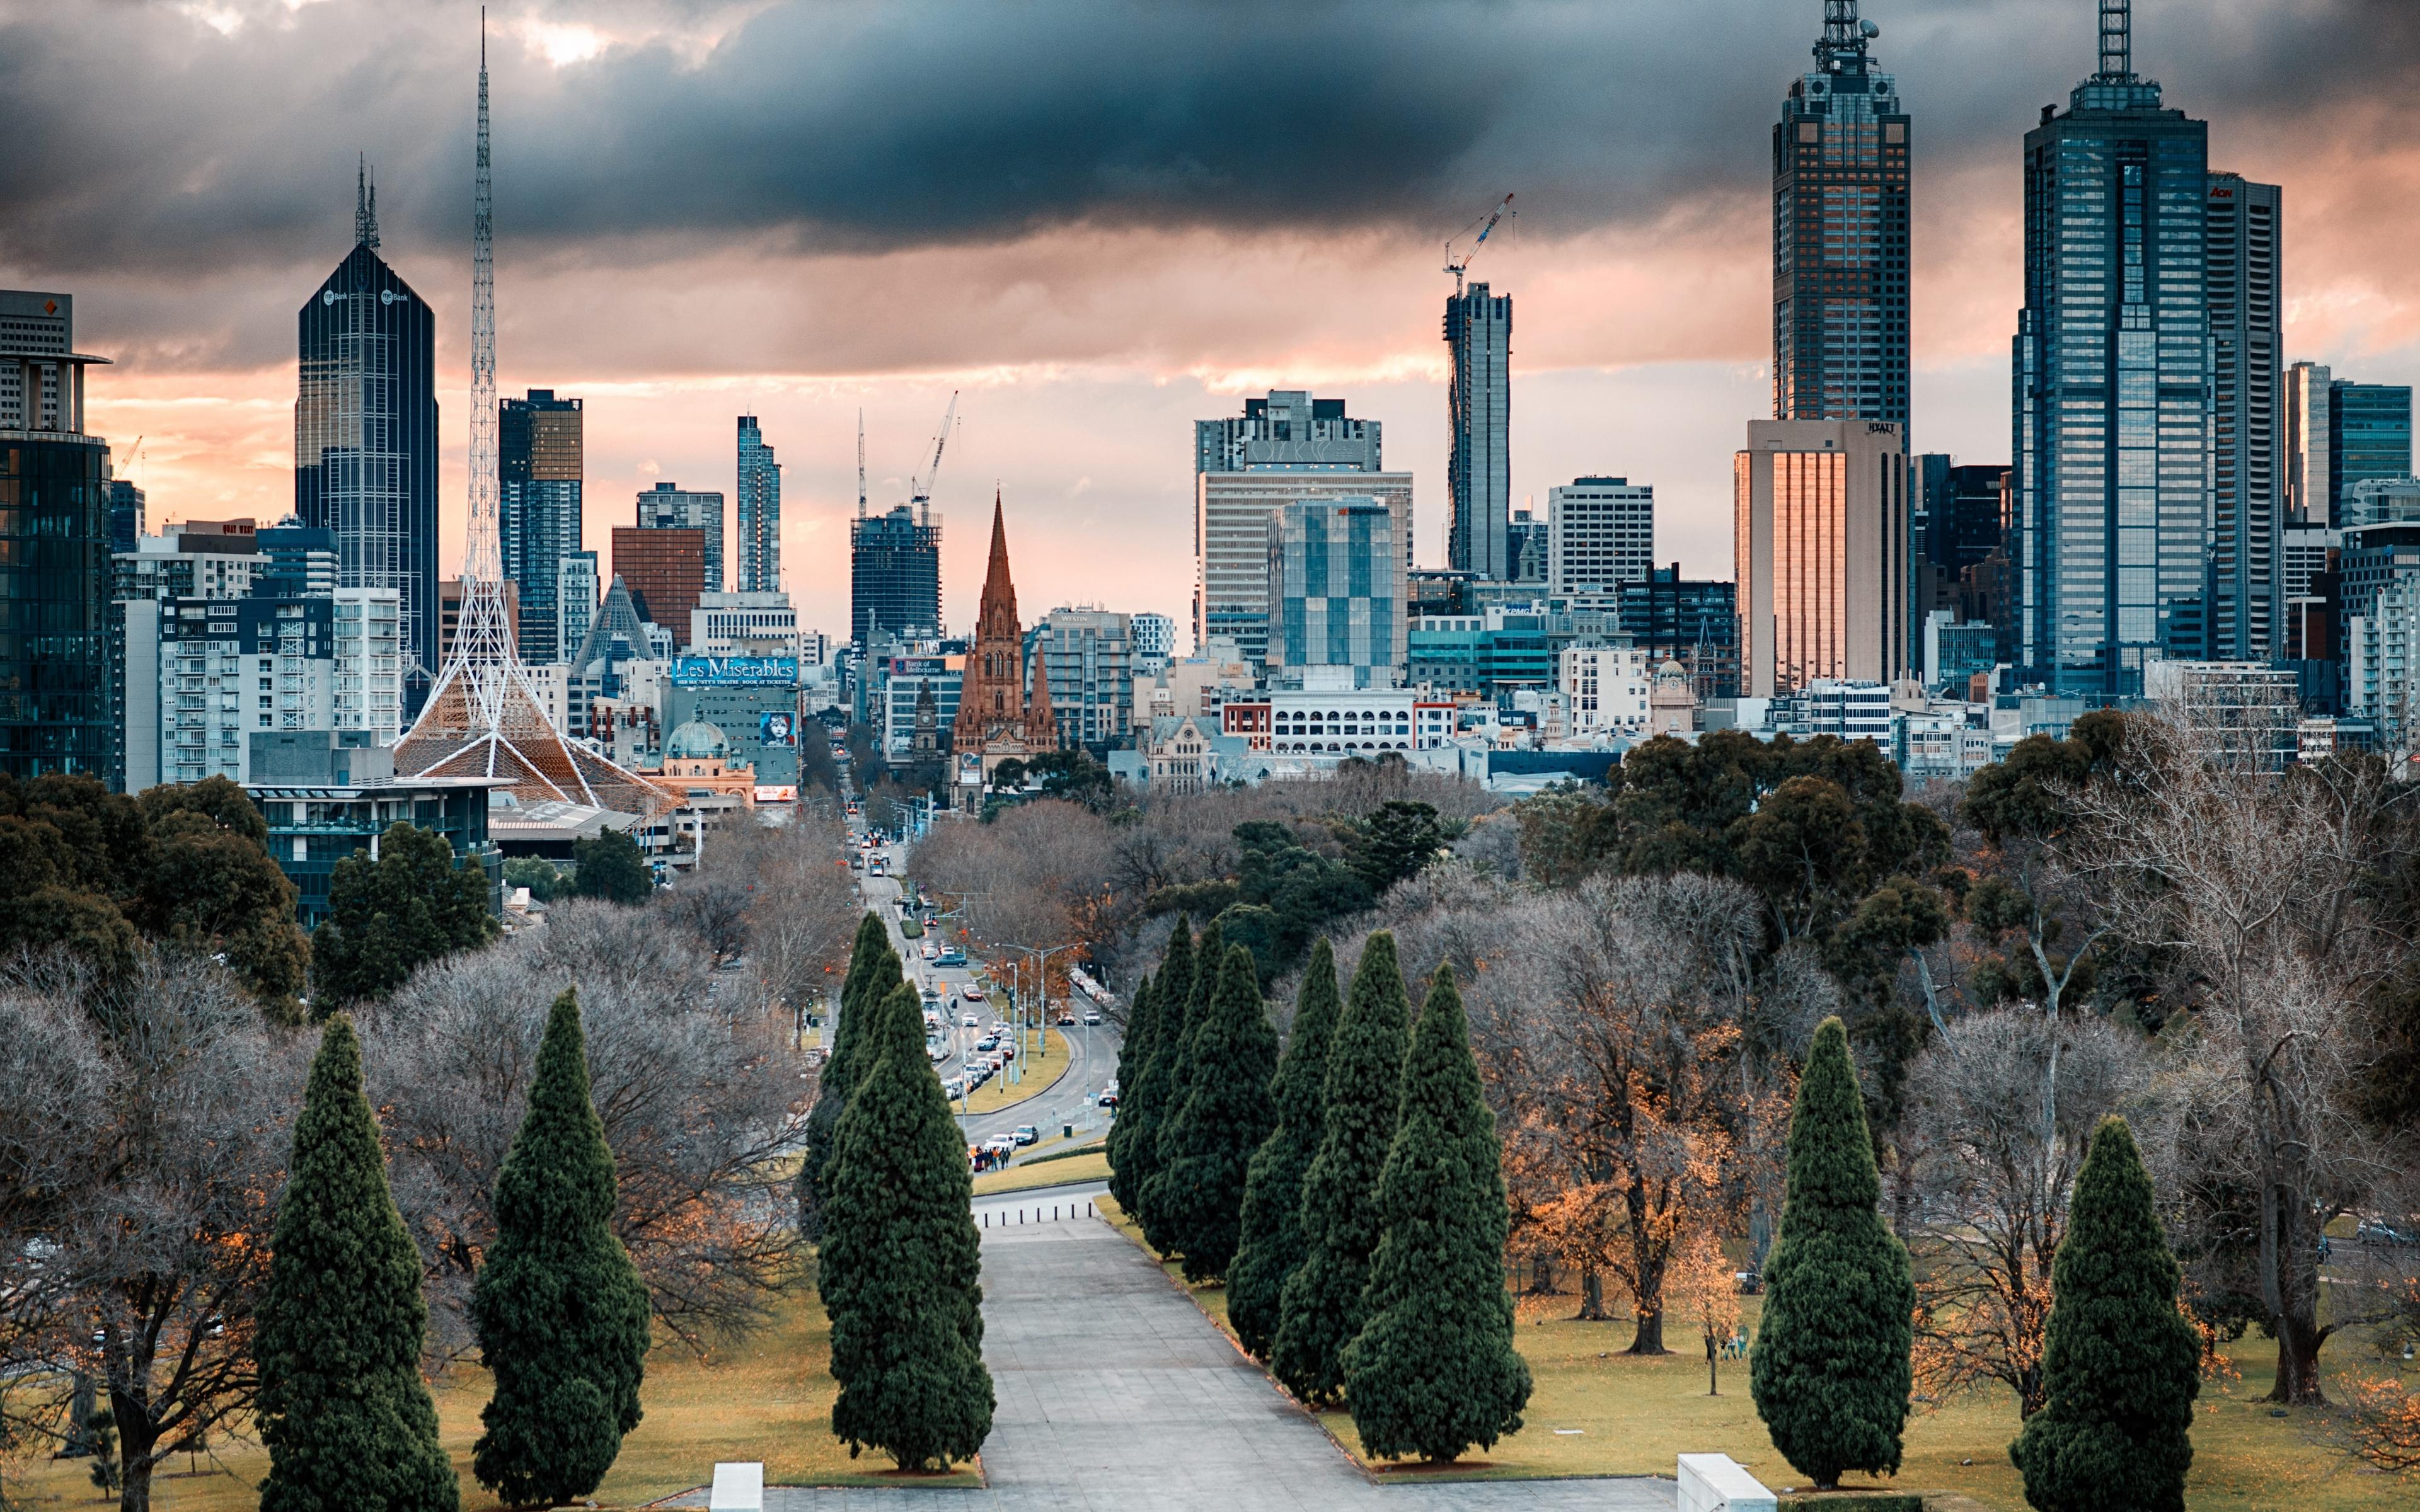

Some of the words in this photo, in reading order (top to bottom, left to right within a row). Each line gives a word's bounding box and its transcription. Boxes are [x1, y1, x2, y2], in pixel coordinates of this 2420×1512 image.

[1869, 423, 1895, 433] HYATT
[223, 524, 236, 534] QUAY
[239, 525, 253, 534] WEST
[676, 658, 704, 677] Les
[708, 658, 794, 677] Misérables
